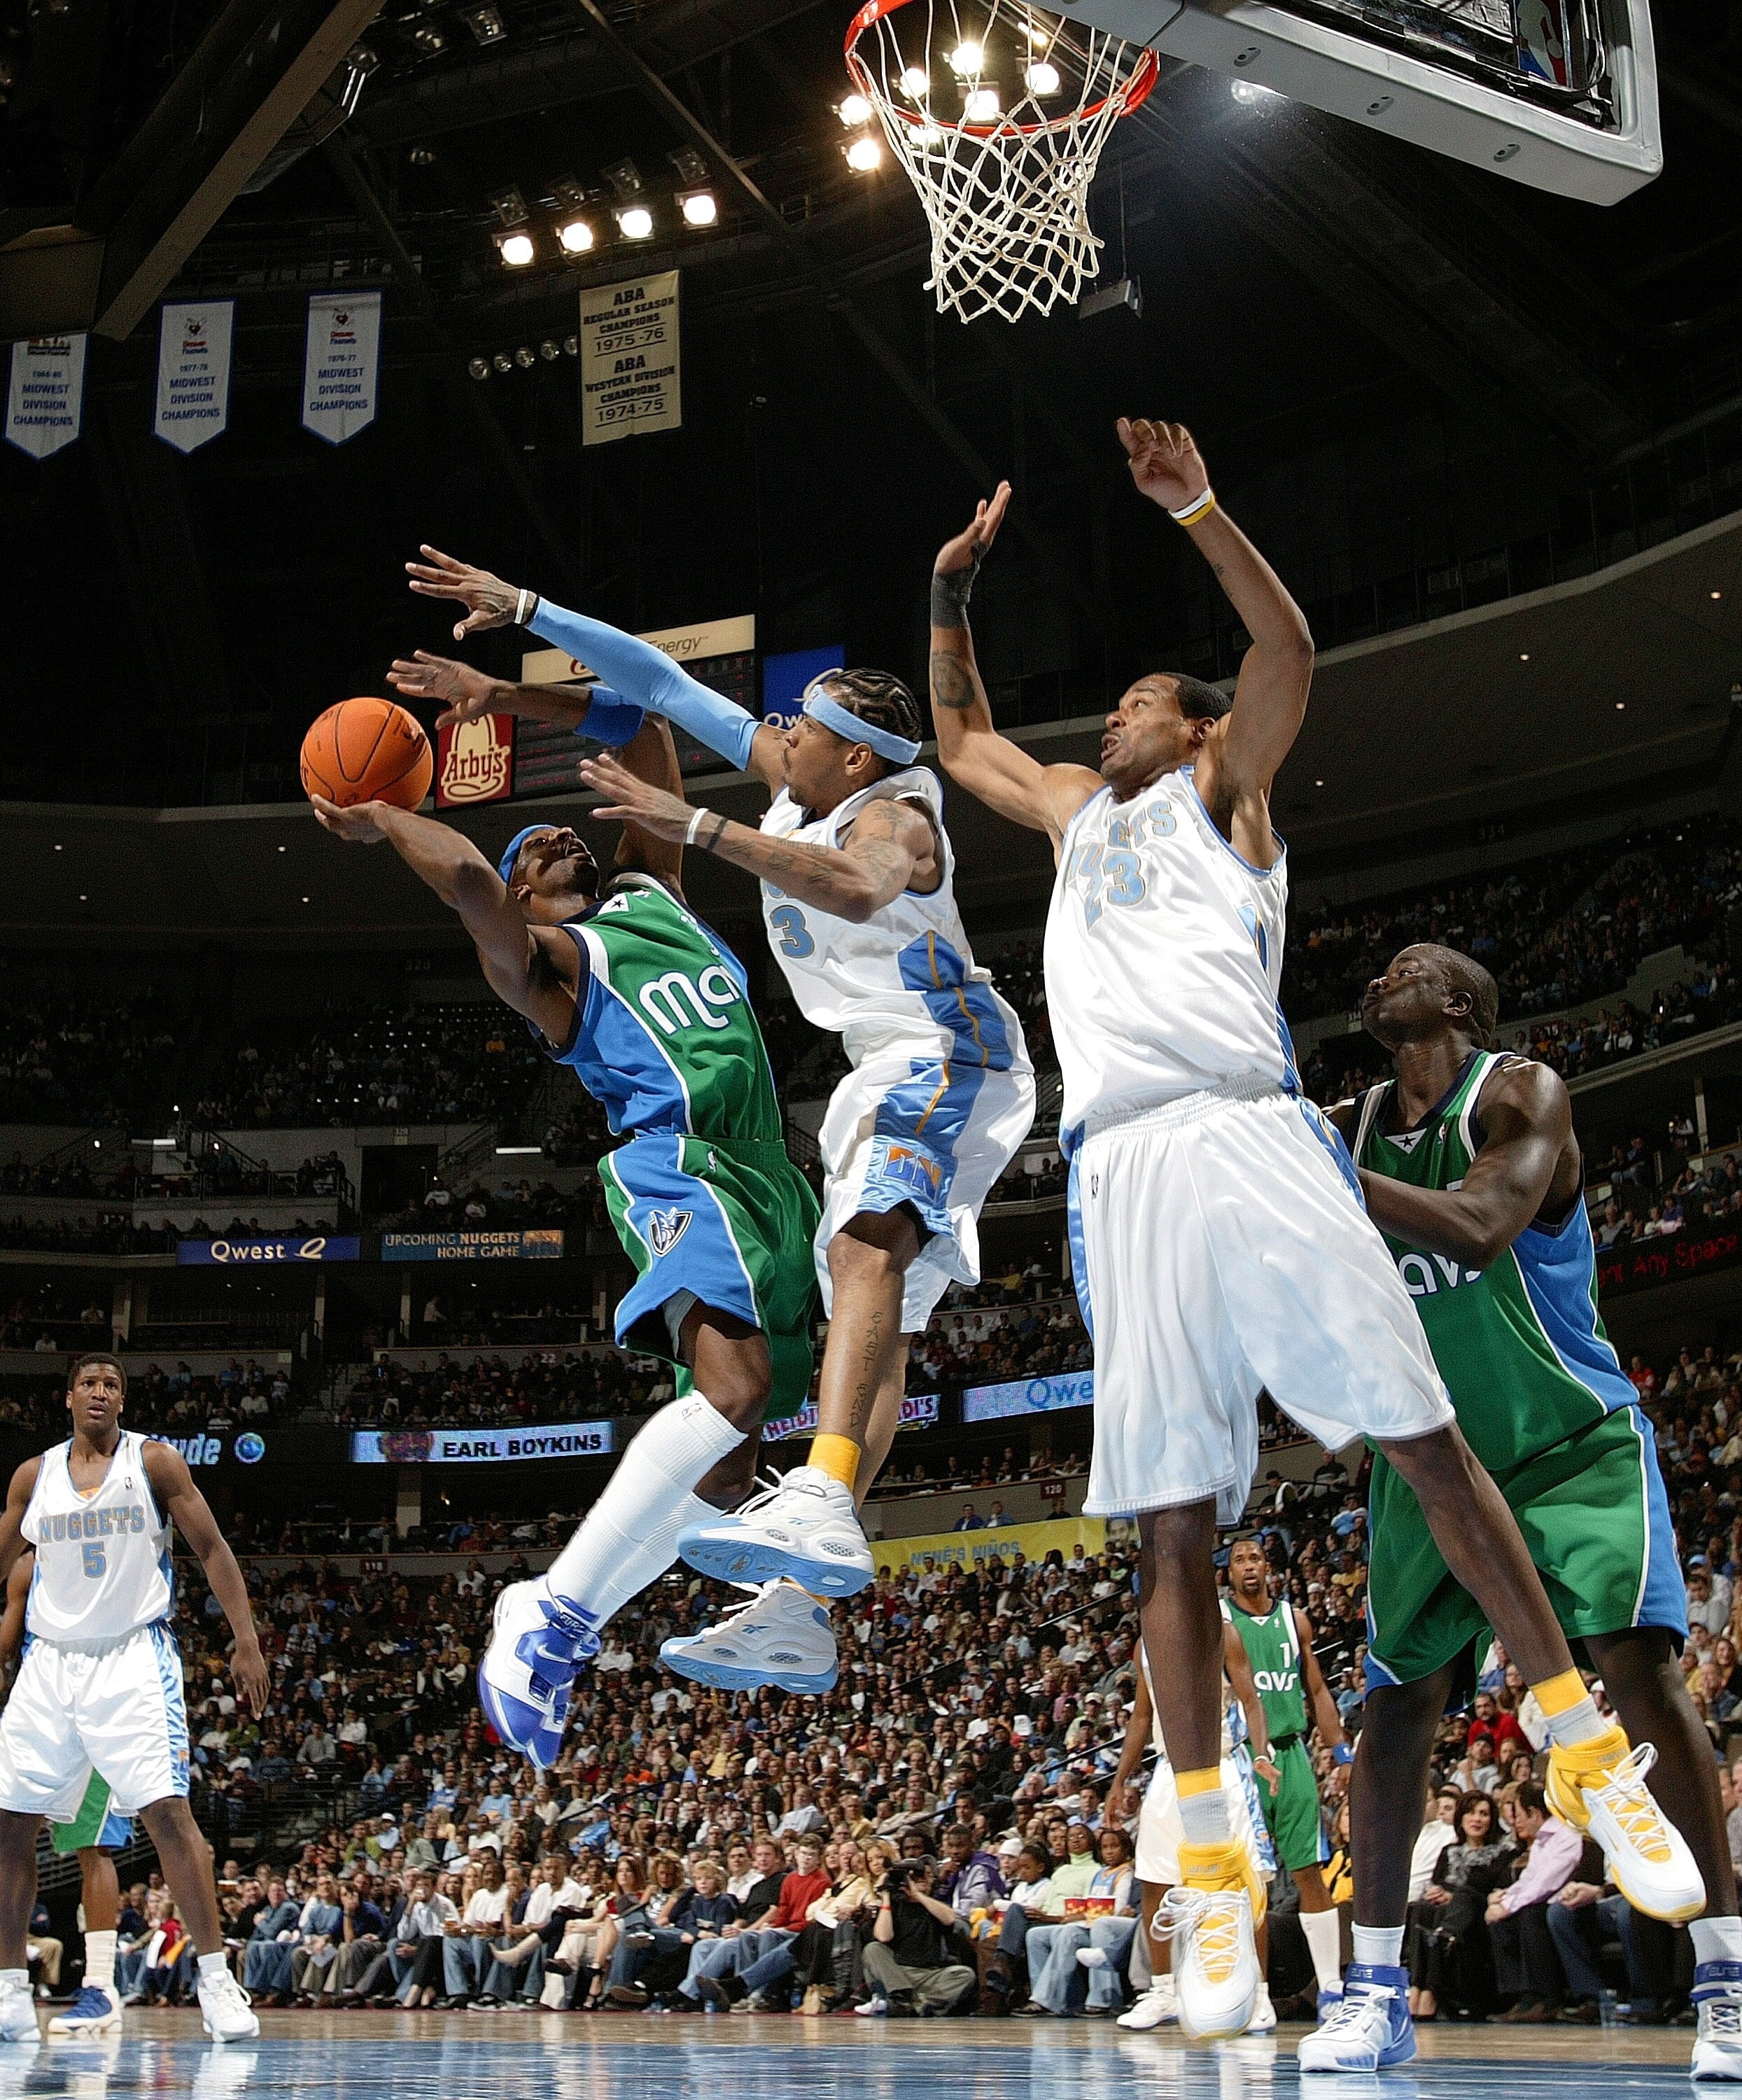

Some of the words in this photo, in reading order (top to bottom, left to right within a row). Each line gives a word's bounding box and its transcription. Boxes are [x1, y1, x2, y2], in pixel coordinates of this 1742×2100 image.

[613, 287, 645, 306] ABA
[583, 307, 631, 325] REGULAR
[634, 296, 675, 314] SEASON
[599, 313, 660, 335] CHAMPIONS
[318, 368, 364, 379] MIDWEST
[614, 355, 646, 374] ABA
[22, 384, 69, 394] MIDWEST
[169, 376, 216, 389] MIDWEST
[318, 384, 361, 395] DIVISION
[585, 374, 631, 393] WESTERN
[635, 365, 675, 383] DIVISION
[171, 393, 213, 404] DIVISION
[600, 383, 661, 404] CHAMPIONS
[22, 400, 66, 410] DIVISION
[162, 408, 220, 421] CHAMPIONS
[310, 400, 367, 412] CHAMPIONS
[598, 398, 663, 421] 1974-75
[13, 415, 73, 426] CHAMPIONS
[444, 744, 504, 784] Arby's
[769, 904, 815, 959] 3
[638, 964, 741, 1035] ma
[385, 1233, 456, 1247] UPCOMING
[460, 1231, 520, 1245] NUGGETS
[210, 1239, 286, 1263] Qwest
[437, 1247, 477, 1259] HOME
[480, 1245, 520, 1257] GAME
[1027, 1379, 1093, 1409] Qwe
[443, 1441, 501, 1458] EARL
[507, 1433, 602, 1457] BOYKINS
[38, 1505, 146, 1544] NUGGETS
[82, 1541, 106, 1578] 5
[1253, 1670, 1299, 1692] avs
